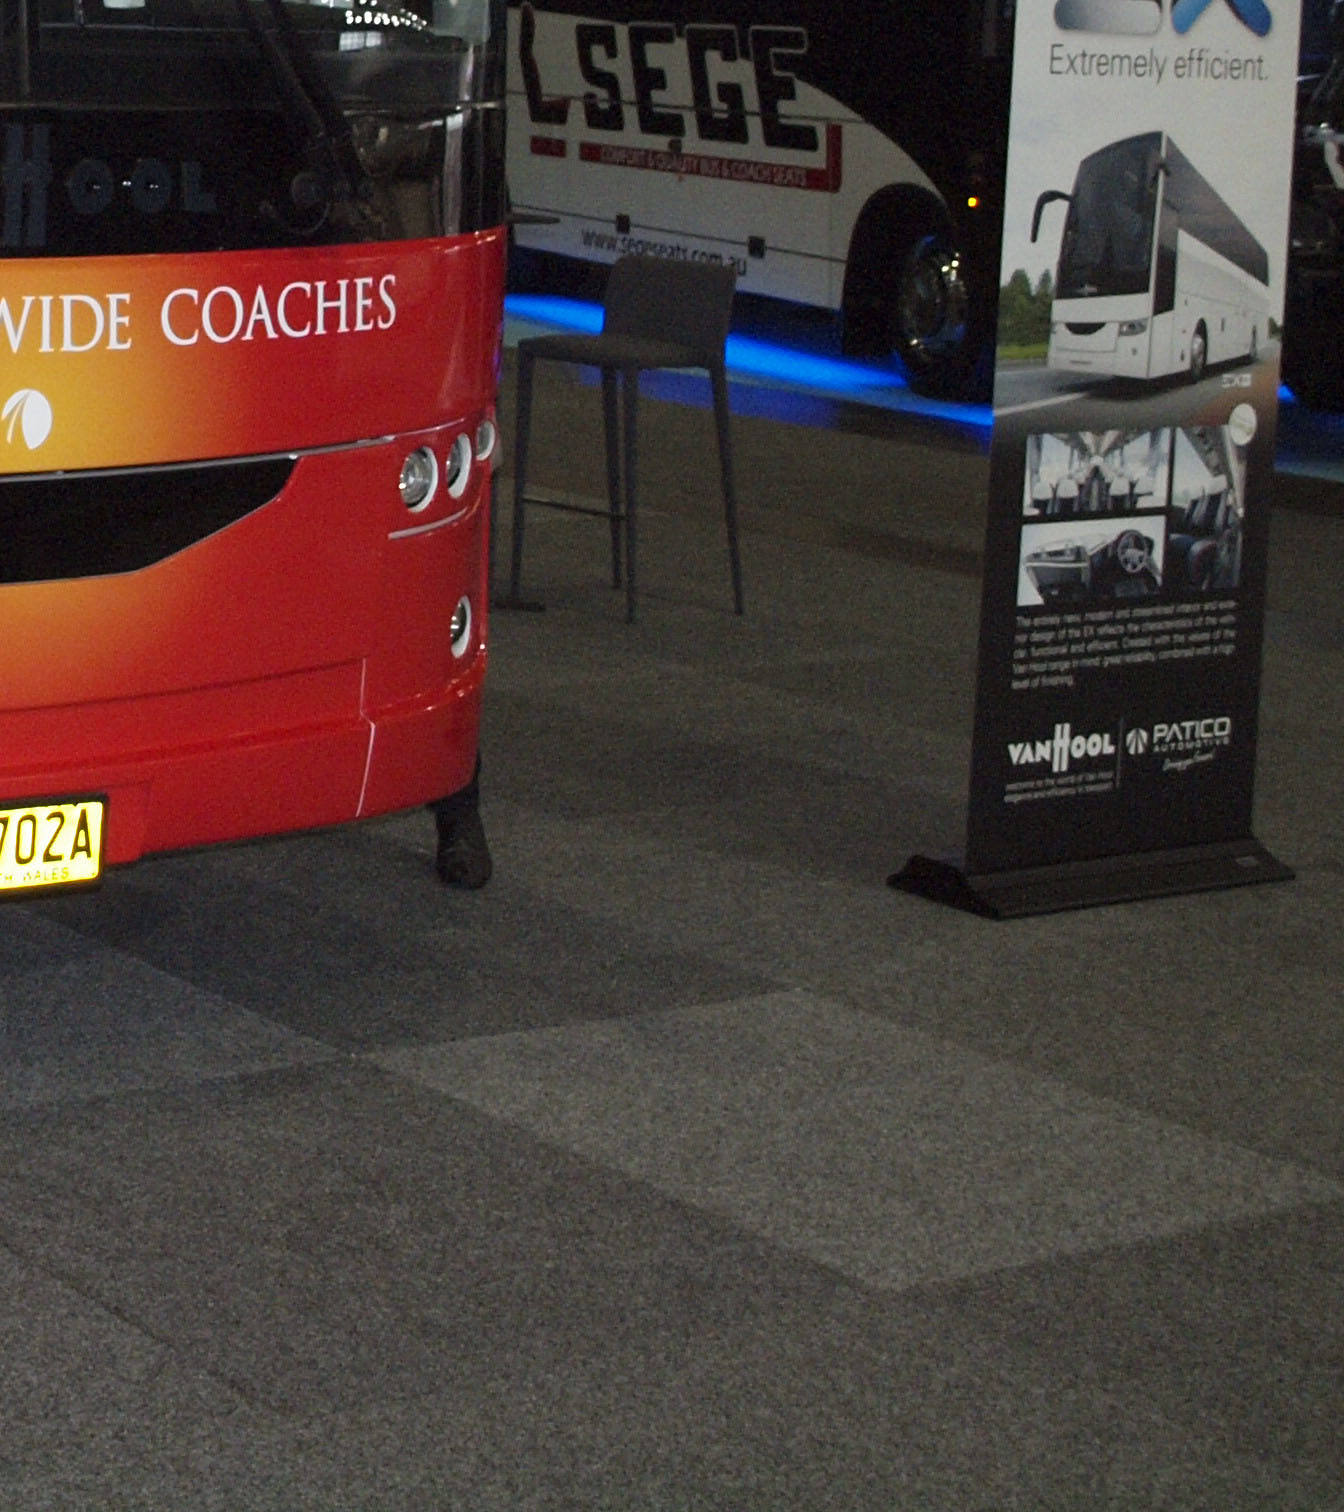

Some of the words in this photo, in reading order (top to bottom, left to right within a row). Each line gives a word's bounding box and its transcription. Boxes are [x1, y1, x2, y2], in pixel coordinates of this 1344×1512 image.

[1049, 43, 1166, 84] Extremely
[1175, 48, 1269, 81] efficient.
[160, 274, 398, 346] COACHES
[1153, 716, 1231, 744] PATICO
[22, 866, 70, 884] WALES
